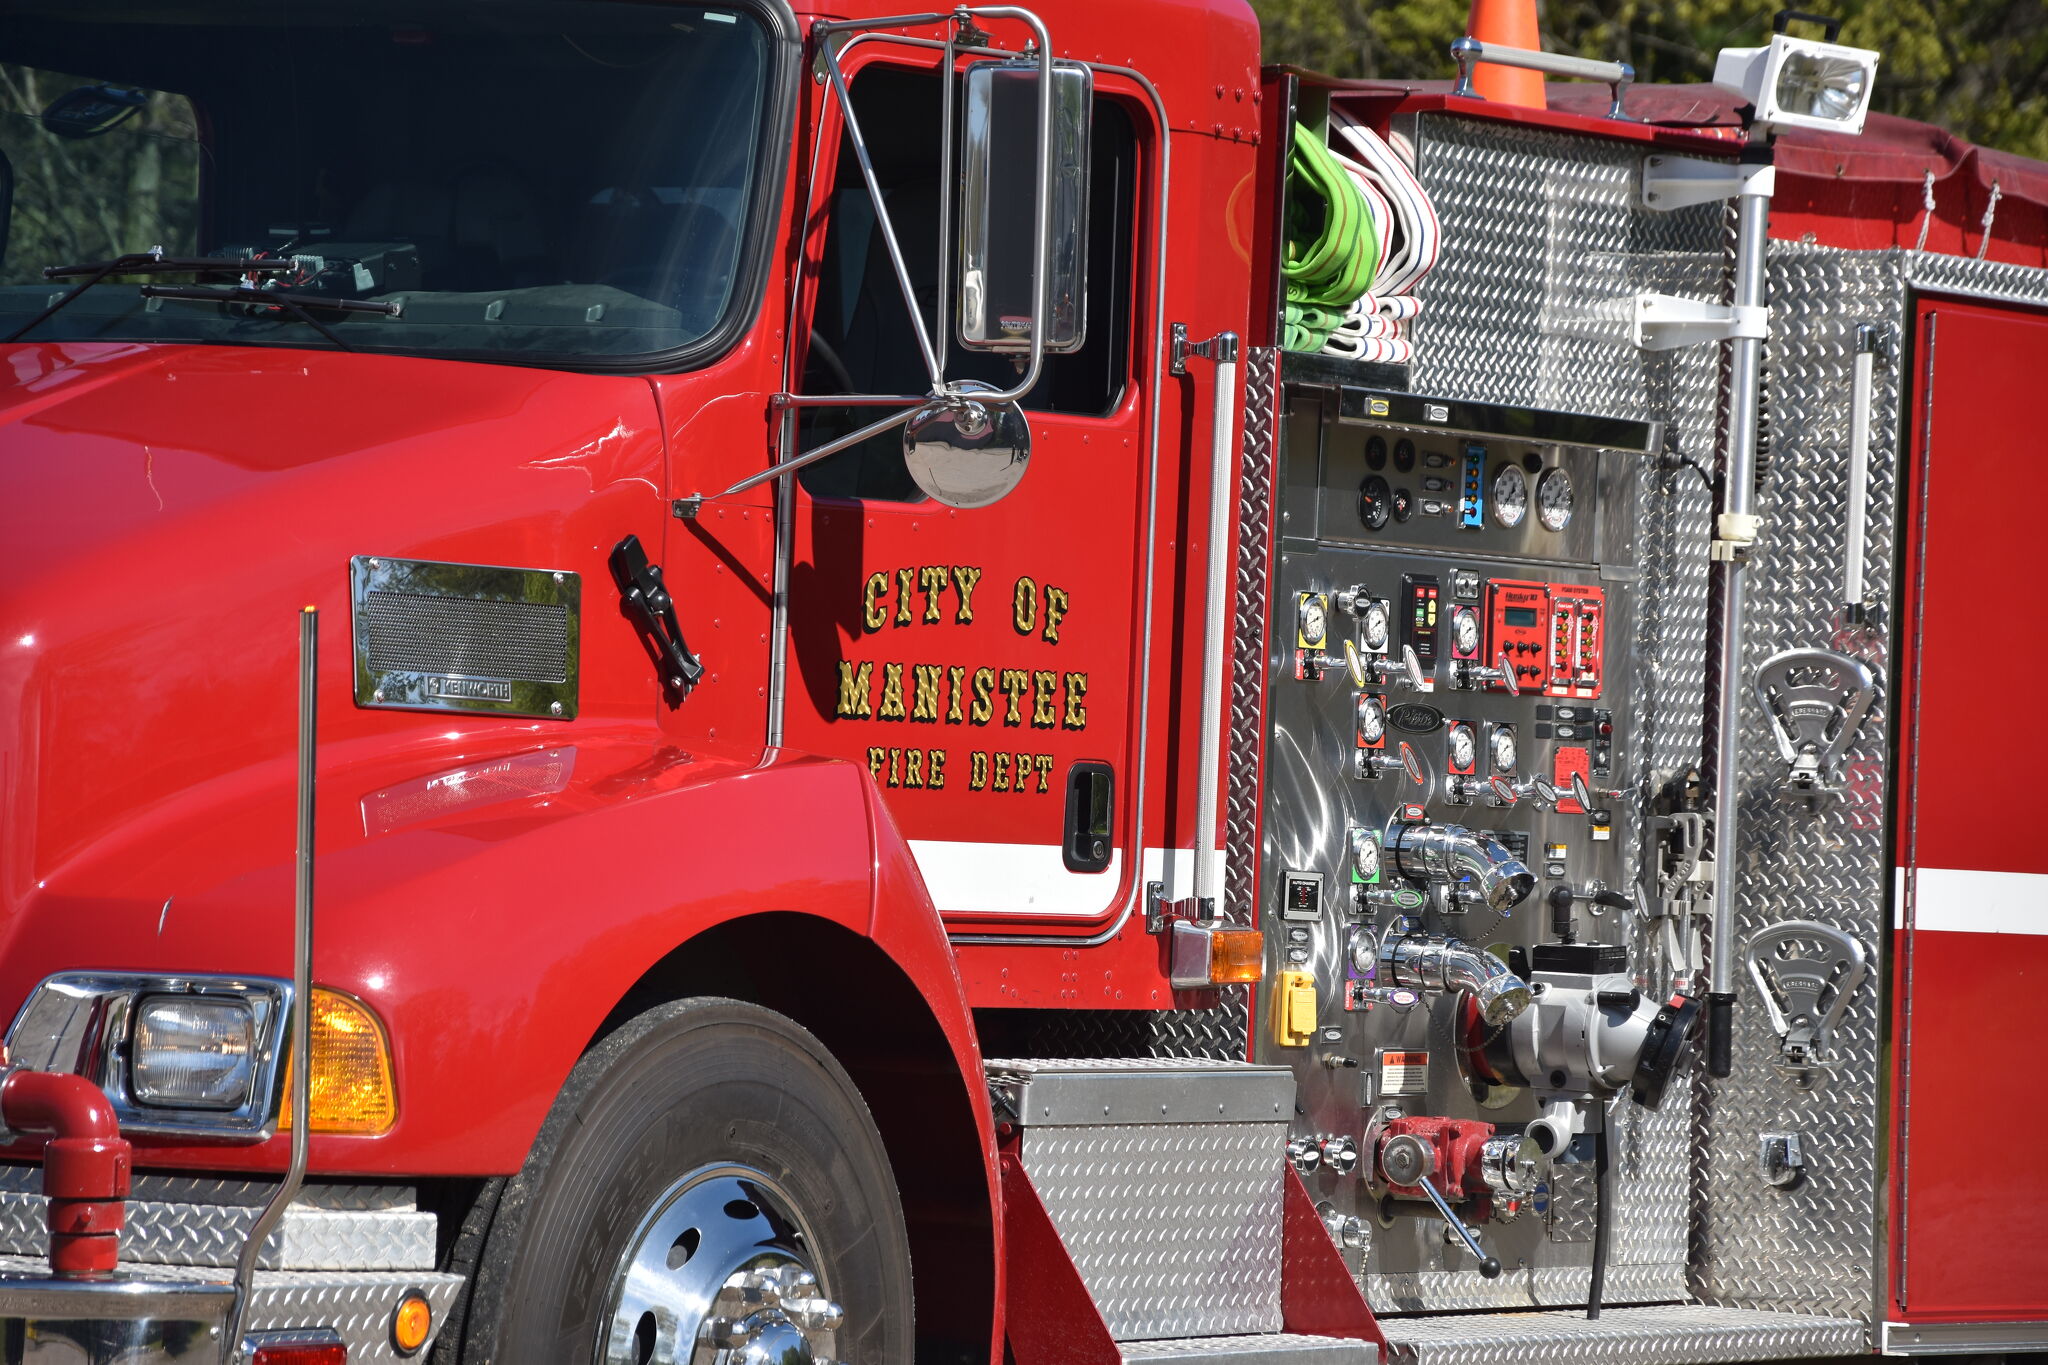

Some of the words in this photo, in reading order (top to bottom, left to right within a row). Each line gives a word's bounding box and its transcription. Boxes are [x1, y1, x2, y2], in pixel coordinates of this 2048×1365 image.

[863, 565, 981, 635] CITY
[1012, 576, 1069, 645] OF
[443, 679, 509, 699] KENWORTH
[836, 660, 1088, 731] MANISTEE
[867, 746, 946, 789] FIRE
[968, 751, 1054, 793] DEPT
[1395, 1055, 1421, 1064] WARNING
